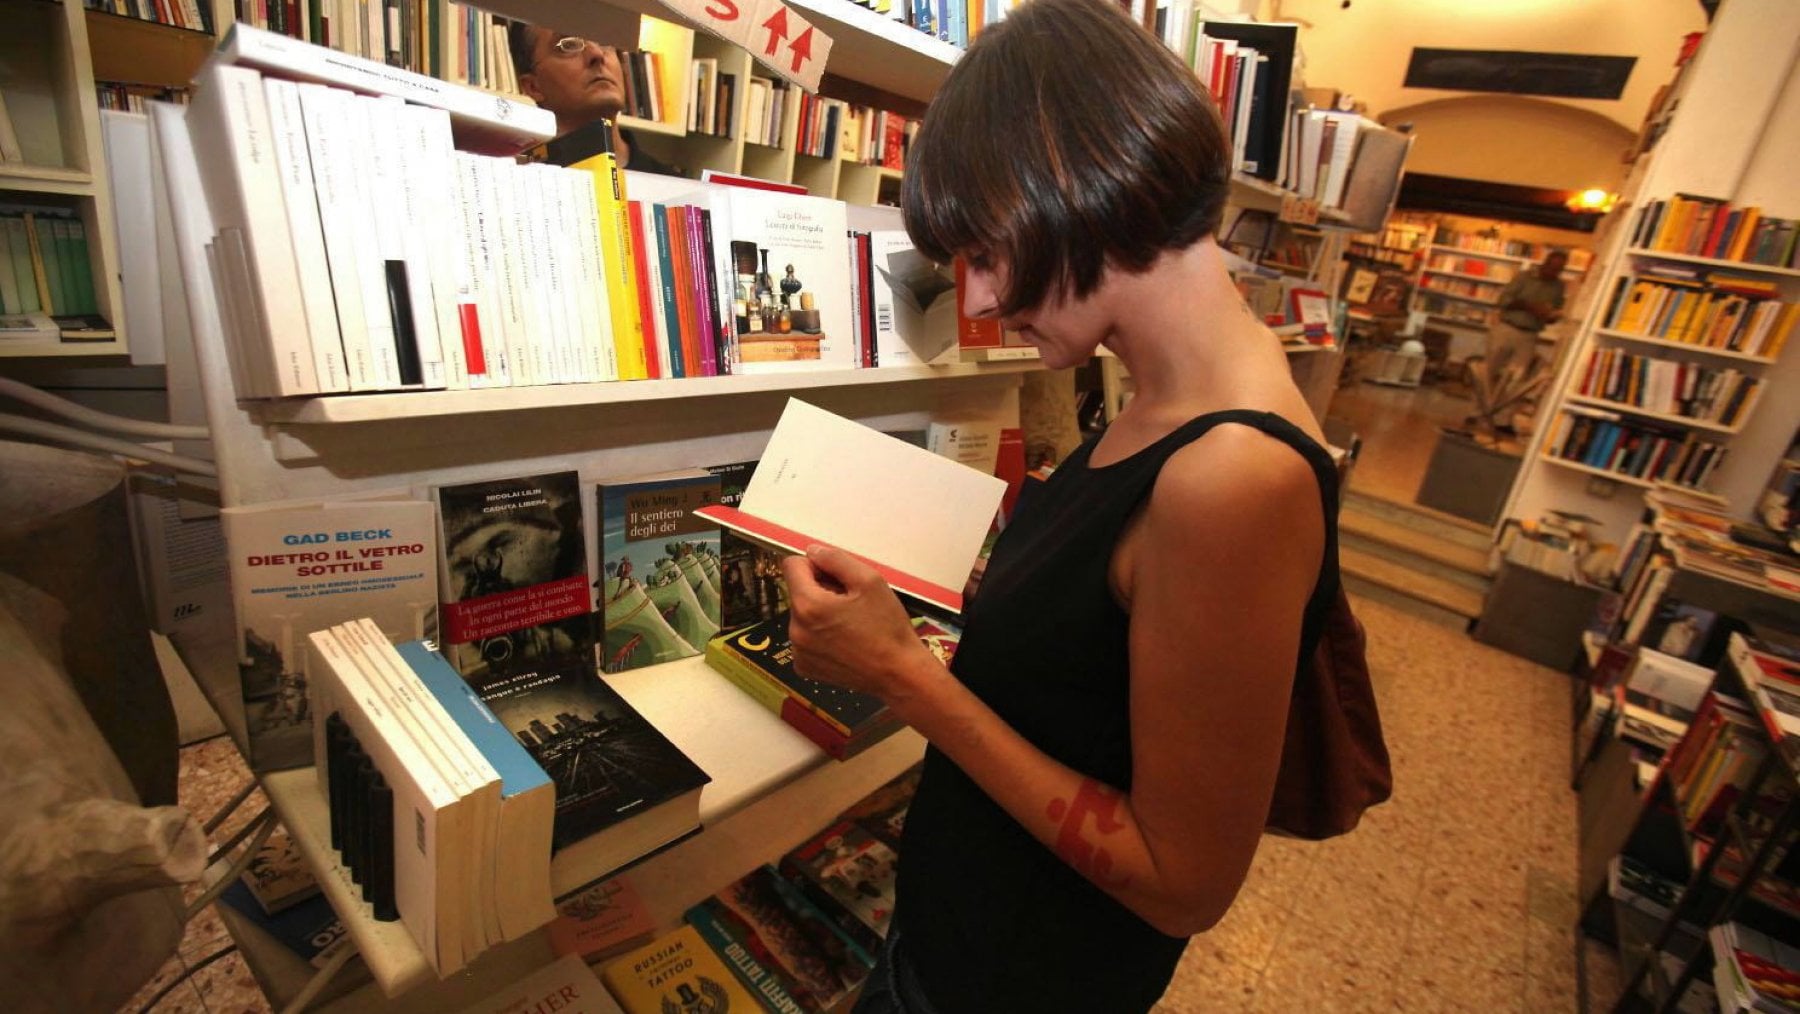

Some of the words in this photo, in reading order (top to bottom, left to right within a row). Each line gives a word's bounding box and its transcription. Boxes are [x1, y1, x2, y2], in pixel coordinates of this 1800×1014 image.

[486, 490, 520, 501] NICOLAI
[720, 495, 733, 504] on
[483, 503, 517, 513] CADUTA
[518, 499, 548, 508] LIBERA
[630, 512, 638, 524] Il
[640, 508, 683, 522] sentiero
[283, 533, 329, 546] GAD
[335, 529, 393, 542] BECK
[630, 523, 657, 537] degli
[660, 521, 676, 532] dei
[247, 552, 330, 567] DIETRO
[335, 550, 354, 561] IL
[358, 544, 424, 559] VETRO
[297, 560, 384, 577] SOTTILE
[634, 941, 684, 973] RUSSIAN
[724, 942, 765, 984] TATTOO
[648, 958, 694, 989] TATTOO
[759, 978, 804, 1014] RAFFITI
